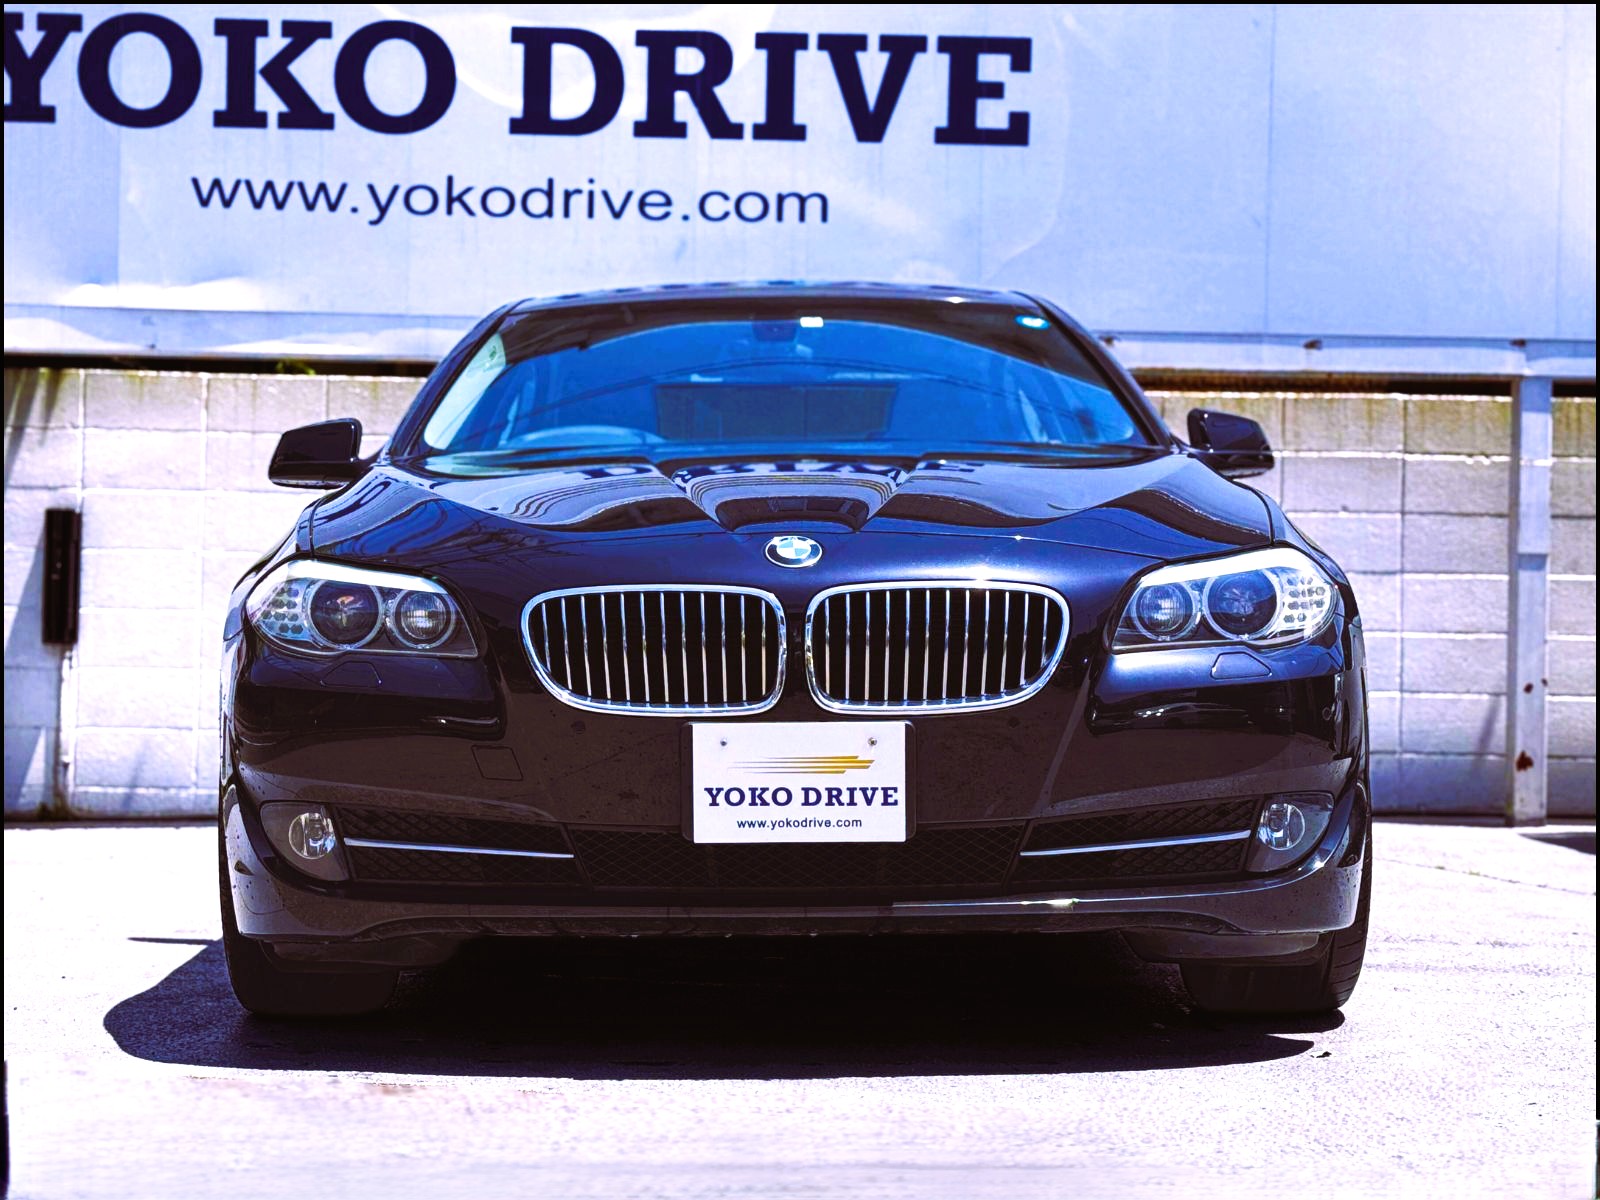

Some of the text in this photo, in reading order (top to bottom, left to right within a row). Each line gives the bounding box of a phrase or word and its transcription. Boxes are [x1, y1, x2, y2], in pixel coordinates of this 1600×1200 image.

[4, 12, 1033, 147] YOKO DRIVE
[191, 175, 829, 226] www.yokodrive.com
[703, 786, 899, 807] YOKO DRIVE
[737, 817, 863, 831] www.yokodrive.com
